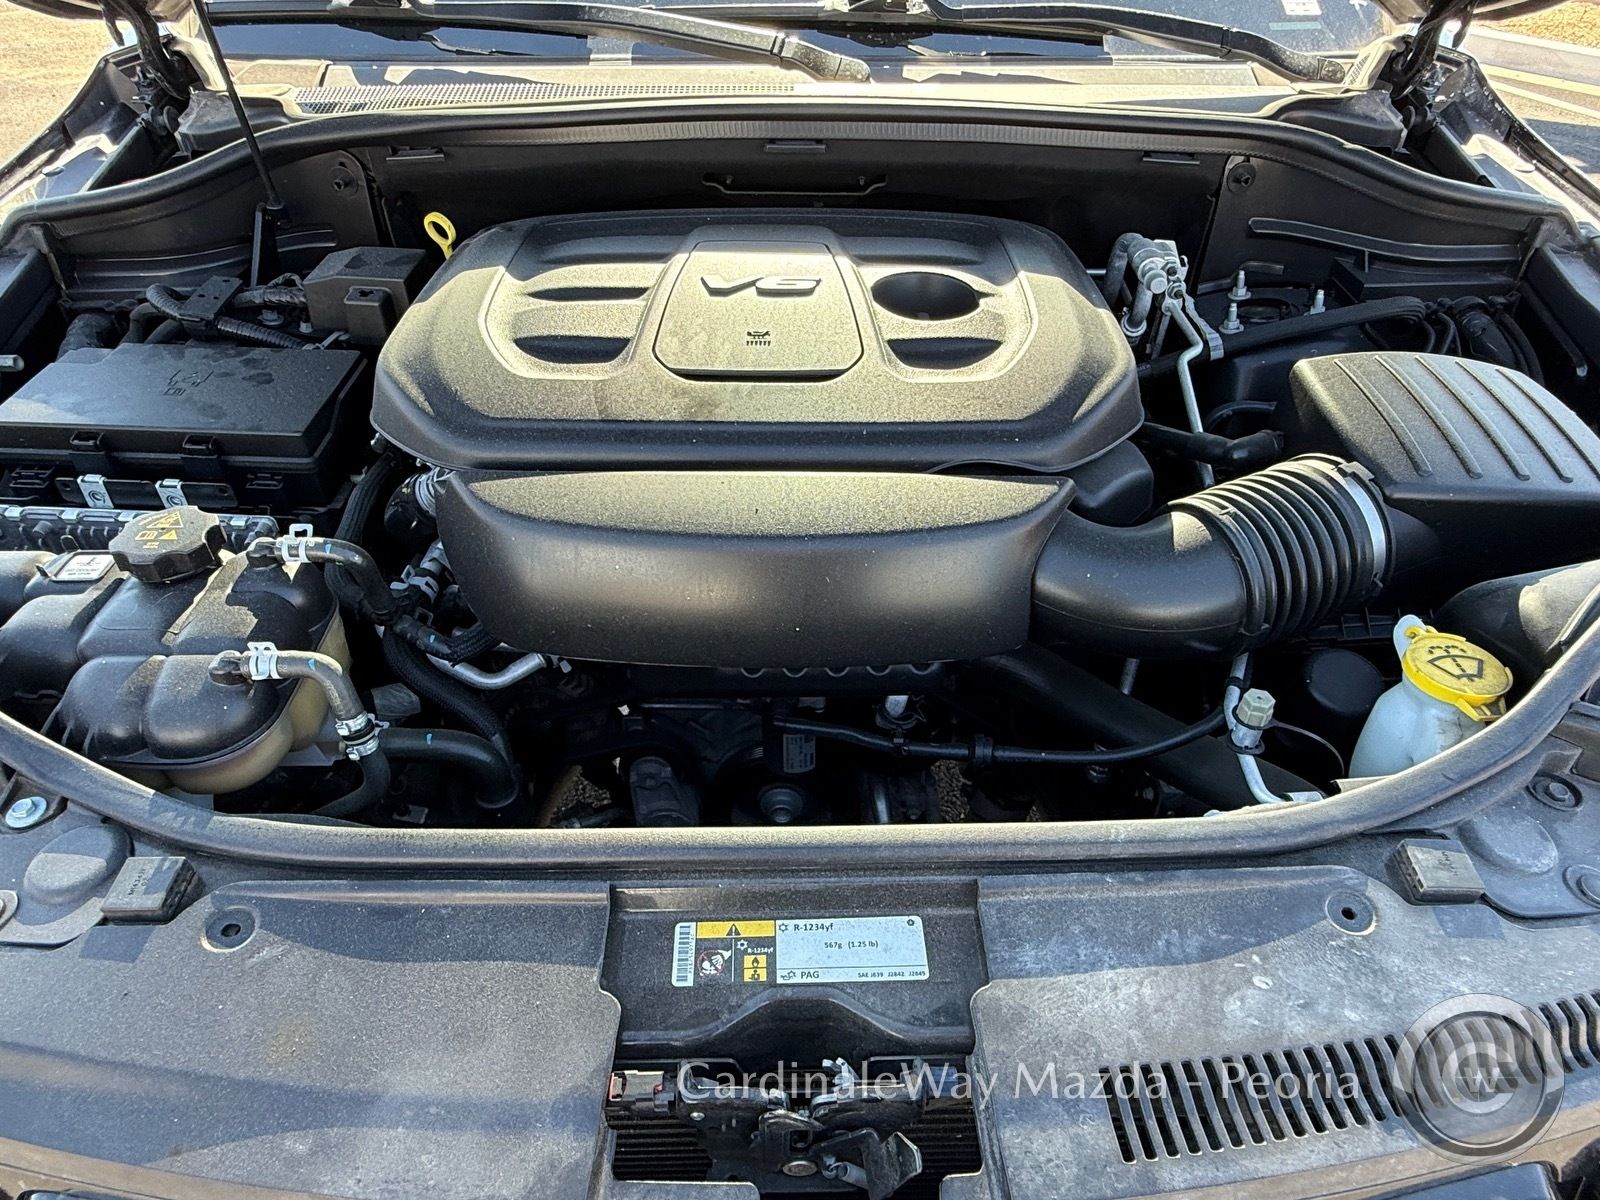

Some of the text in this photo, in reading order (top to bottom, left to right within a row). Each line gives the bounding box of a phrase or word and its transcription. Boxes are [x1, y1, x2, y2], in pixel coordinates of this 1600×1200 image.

[700, 274, 821, 298] V6
[793, 922, 833, 932] R-1234yf
[847, 940, 867, 949] (1.25
[868, 940, 879, 948] lb)
[800, 970, 820, 979] PAG
